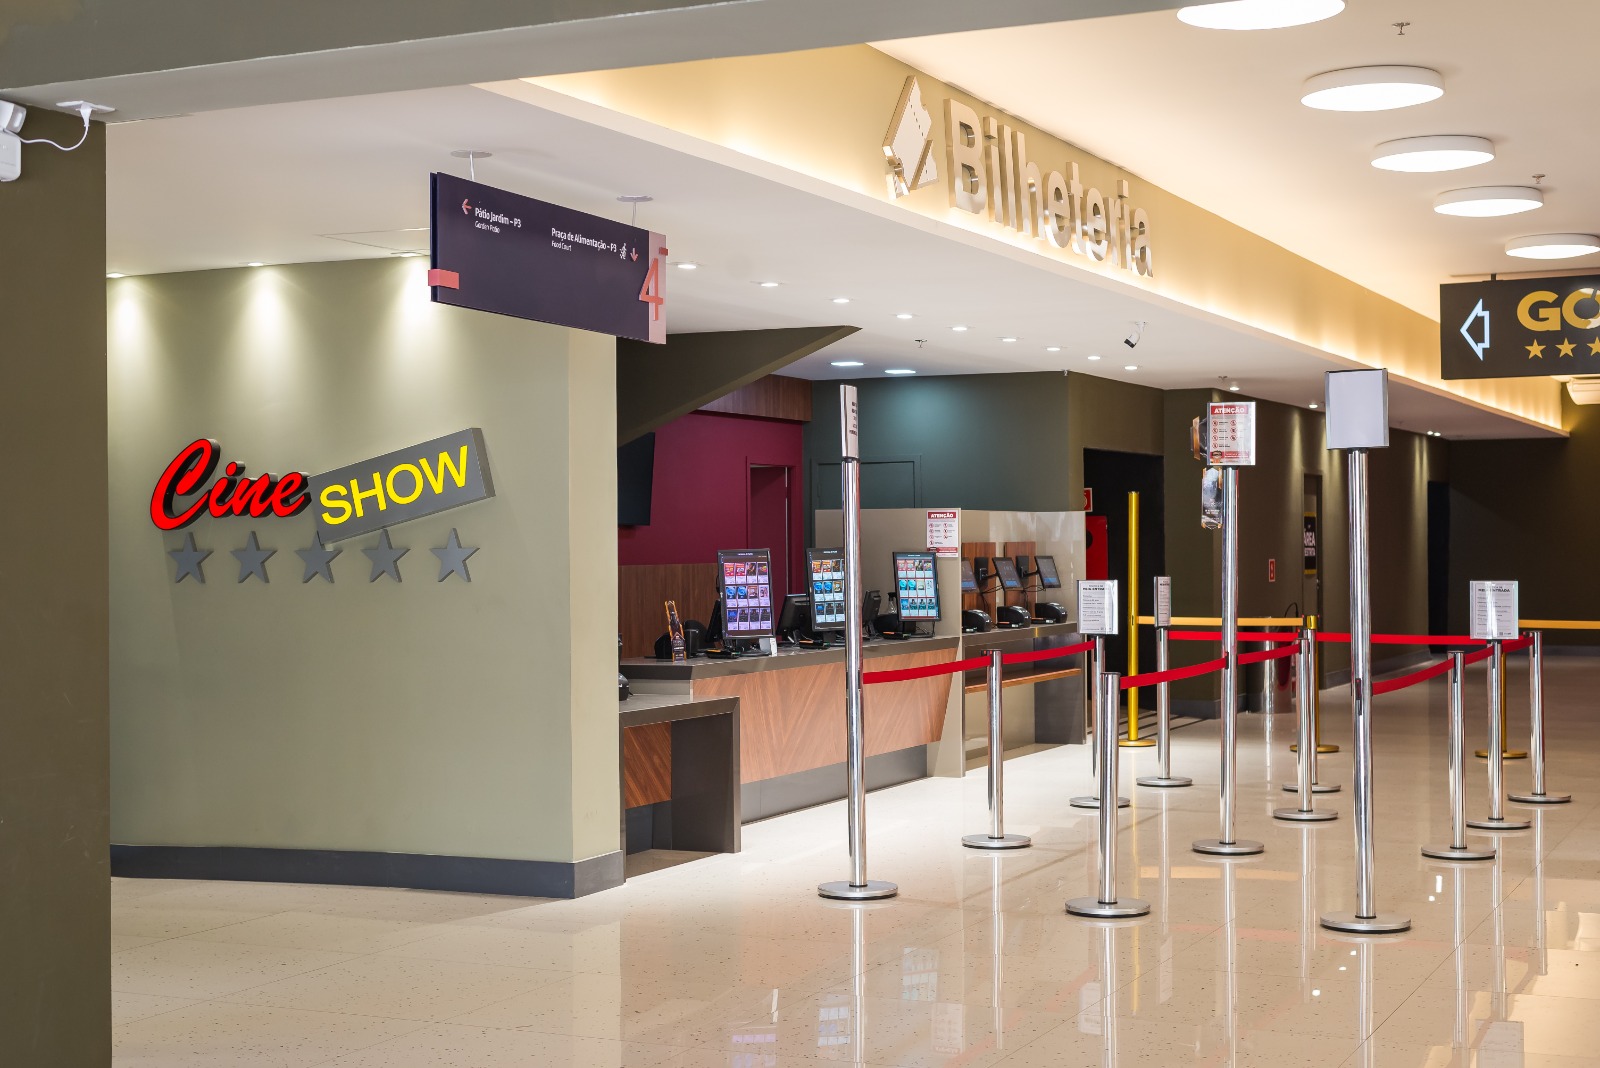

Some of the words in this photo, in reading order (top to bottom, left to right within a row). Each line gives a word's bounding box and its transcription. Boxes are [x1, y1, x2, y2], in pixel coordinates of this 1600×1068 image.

[944, 98, 1153, 278] Bilheteria
[490, 211, 509, 225] Jardim
[514, 218, 522, 228] P3
[552, 227, 567, 241] Praça
[567, 231, 574, 241] de
[574, 233, 607, 252] Alimentação
[611, 243, 617, 252] P3
[552, 240, 562, 249] Food
[639, 257, 664, 321] 4
[1214, 406, 1245, 415] ATENÇÃO
[150, 438, 311, 531] Cine
[320, 445, 468, 525] SHOW
